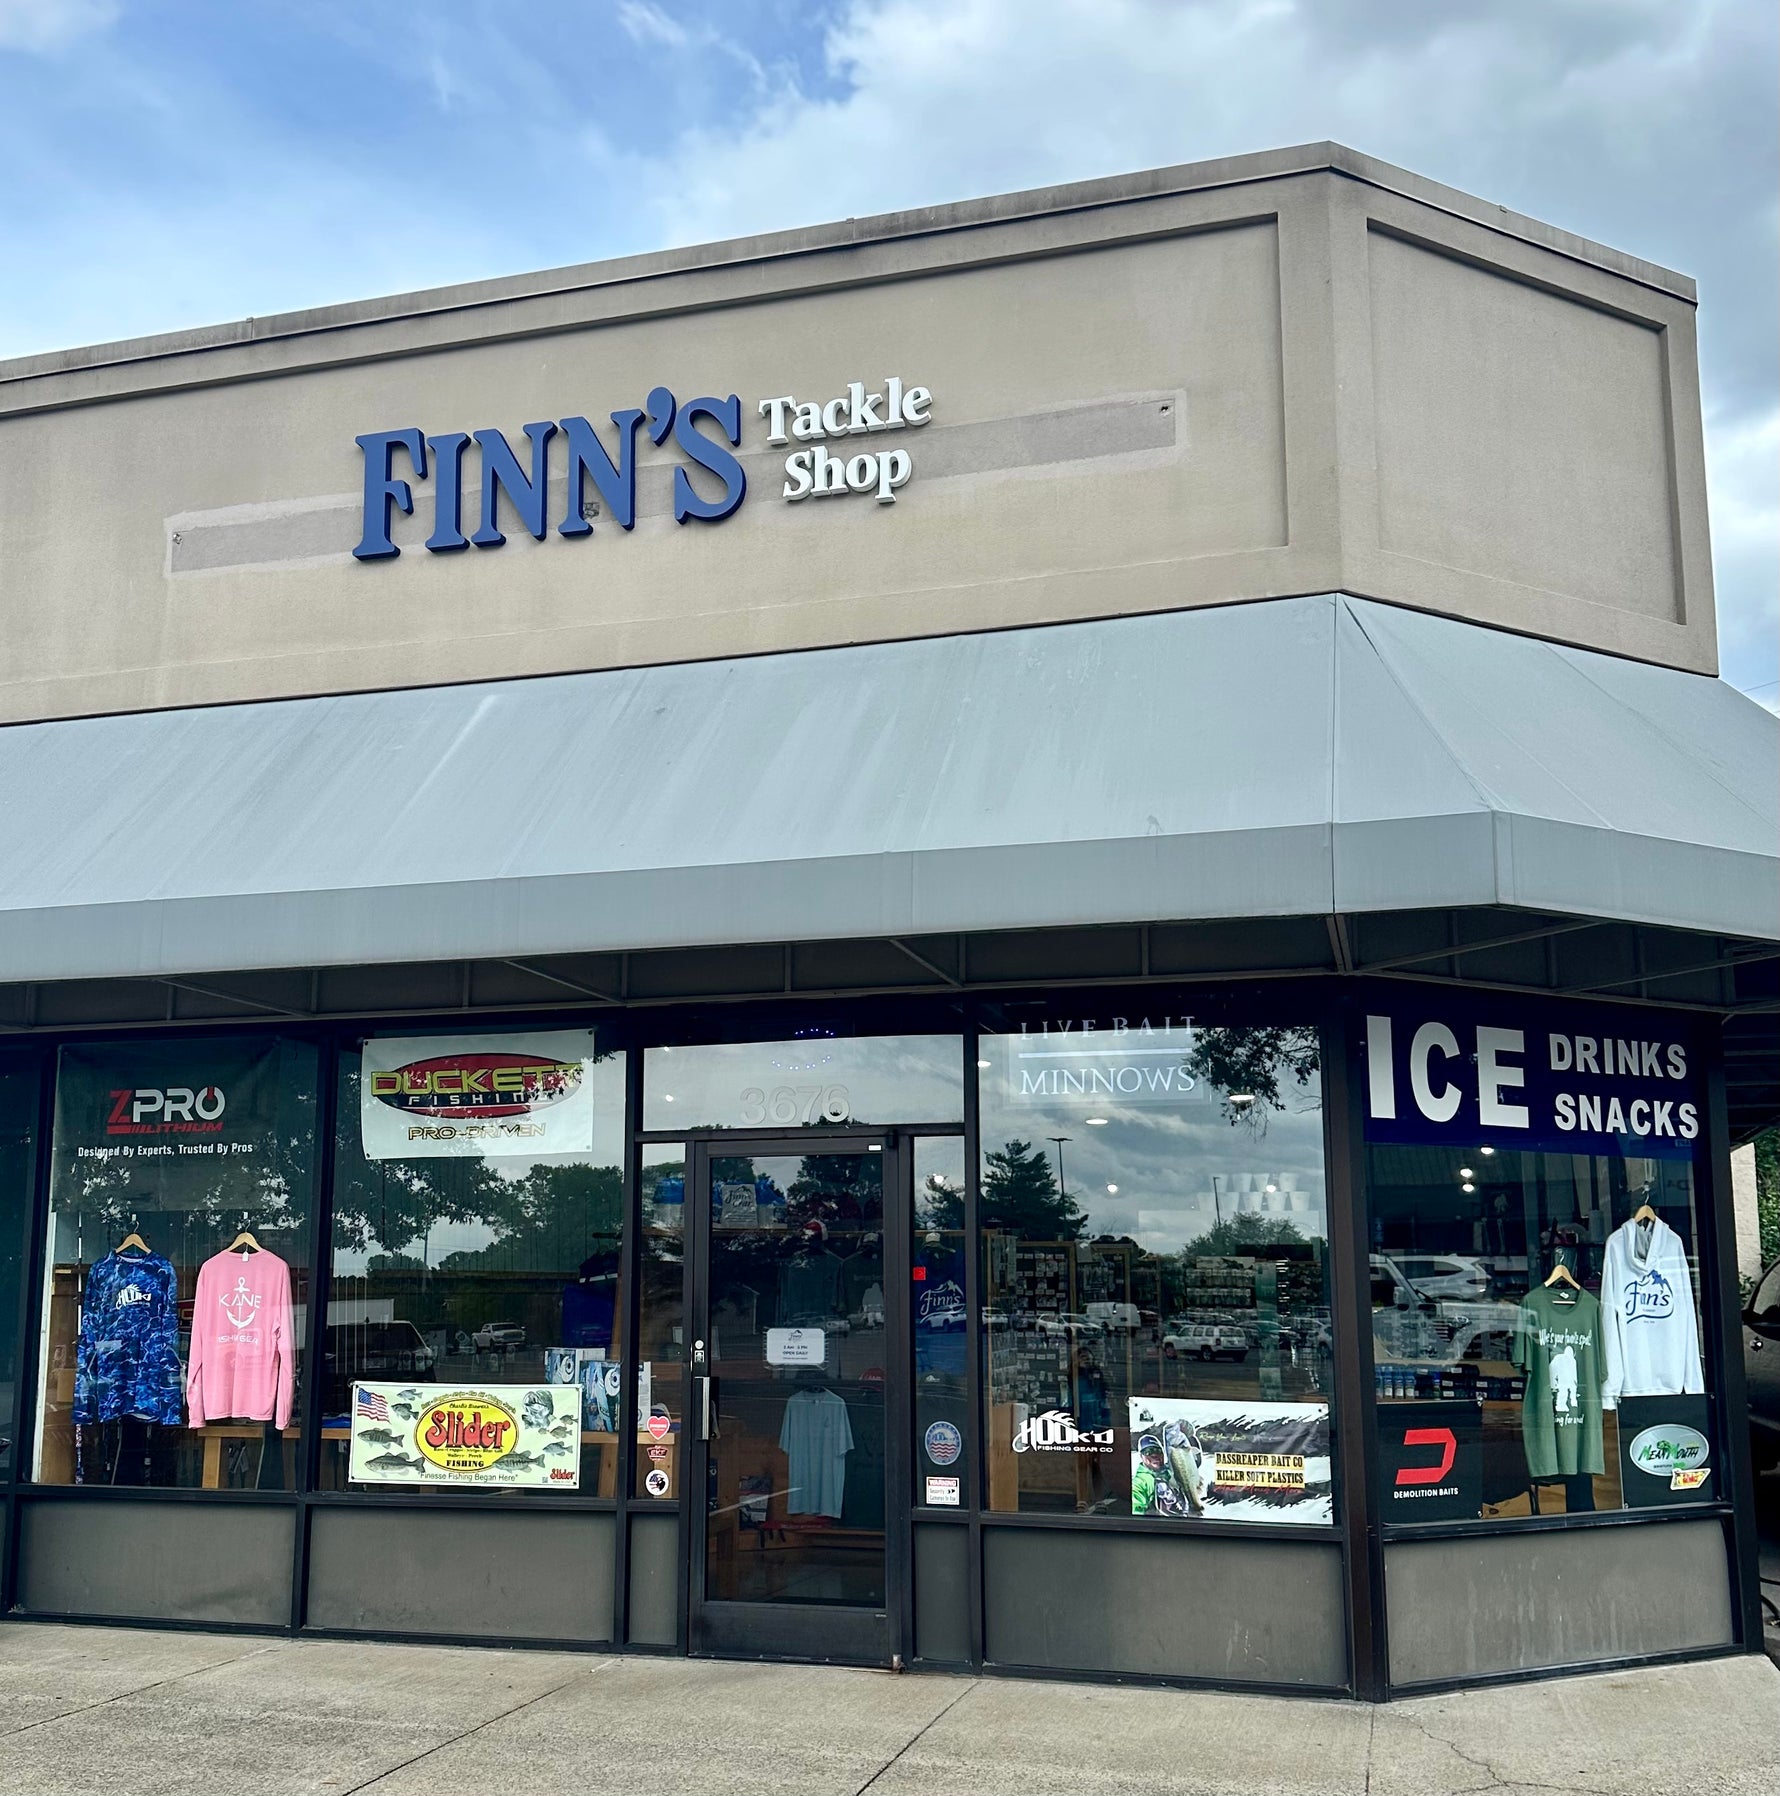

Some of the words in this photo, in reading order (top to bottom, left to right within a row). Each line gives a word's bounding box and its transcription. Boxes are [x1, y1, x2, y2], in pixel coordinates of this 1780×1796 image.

[353, 386, 746, 561] FINN'S
[758, 377, 932, 445] Tackle
[782, 445, 912, 503] Shop
[1020, 1019, 1096, 1041] LIVE
[1112, 1016, 1196, 1038] BAIT
[1549, 1033, 1687, 1080] DRINKS
[1019, 1065, 1196, 1095] MINNOWS
[1366, 1015, 1529, 1128] ICE
[107, 1086, 226, 1123] ZPRO
[408, 1091, 548, 1106] FISHIN
[740, 1084, 851, 1125] 3676
[144, 1122, 224, 1133] LITHIUM
[1554, 1093, 1699, 1139] SNACKS
[408, 1123, 546, 1140] PRO-DRIVEN
[78, 1146, 120, 1158] Designed
[123, 1146, 134, 1158] By
[138, 1145, 174, 1157] Experts,
[178, 1144, 213, 1155] Trusted
[217, 1143, 228, 1155] By
[232, 1142, 253, 1153] Pros
[218, 1294, 262, 1309] KANE
[425, 1410, 511, 1449] Slider
[1012, 1411, 1114, 1453] HOOK'D
[446, 1460, 484, 1468] FISHING
[1216, 1453, 1269, 1466] BASSREAPER
[1271, 1455, 1291, 1467] BAIT
[1293, 1456, 1303, 1468] CO
[449, 1473, 473, 1482] Fishing
[475, 1474, 497, 1482] Began
[1216, 1470, 1245, 1481] KILLER
[1246, 1471, 1265, 1482] SOFT
[1267, 1472, 1304, 1484] PLASTICS
[1394, 1489, 1438, 1499] DEMOLITION
[1439, 1487, 1459, 1496] BAITS
